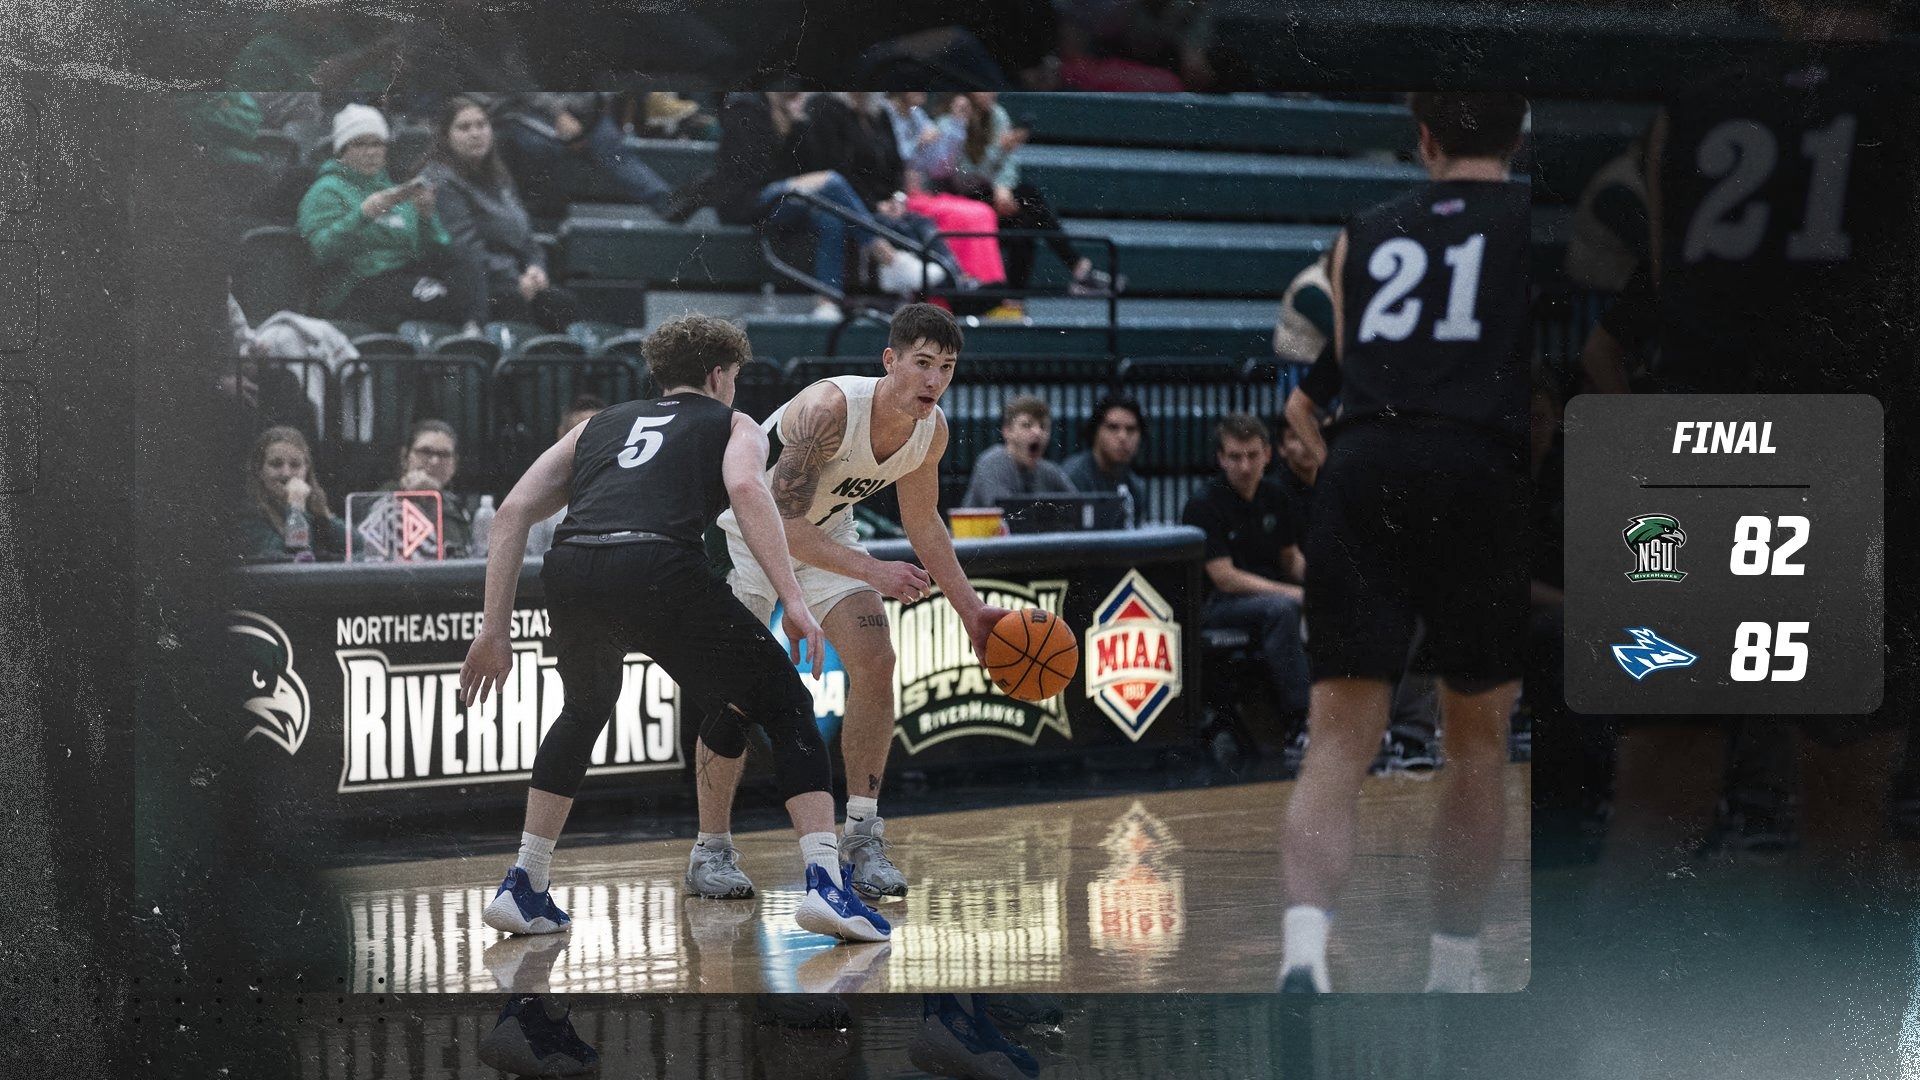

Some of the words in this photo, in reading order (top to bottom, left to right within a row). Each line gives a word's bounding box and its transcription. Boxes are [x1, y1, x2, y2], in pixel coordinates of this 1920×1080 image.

[1358, 234, 1487, 343] 21
[617, 413, 677, 469] 5
[830, 477, 887, 498] NSU
[336, 611, 486, 646] NORTHEASTER
[509, 608, 552, 640] STAT
[1097, 631, 1172, 677] MIAA
[347, 650, 676, 783] RIVERHKS
